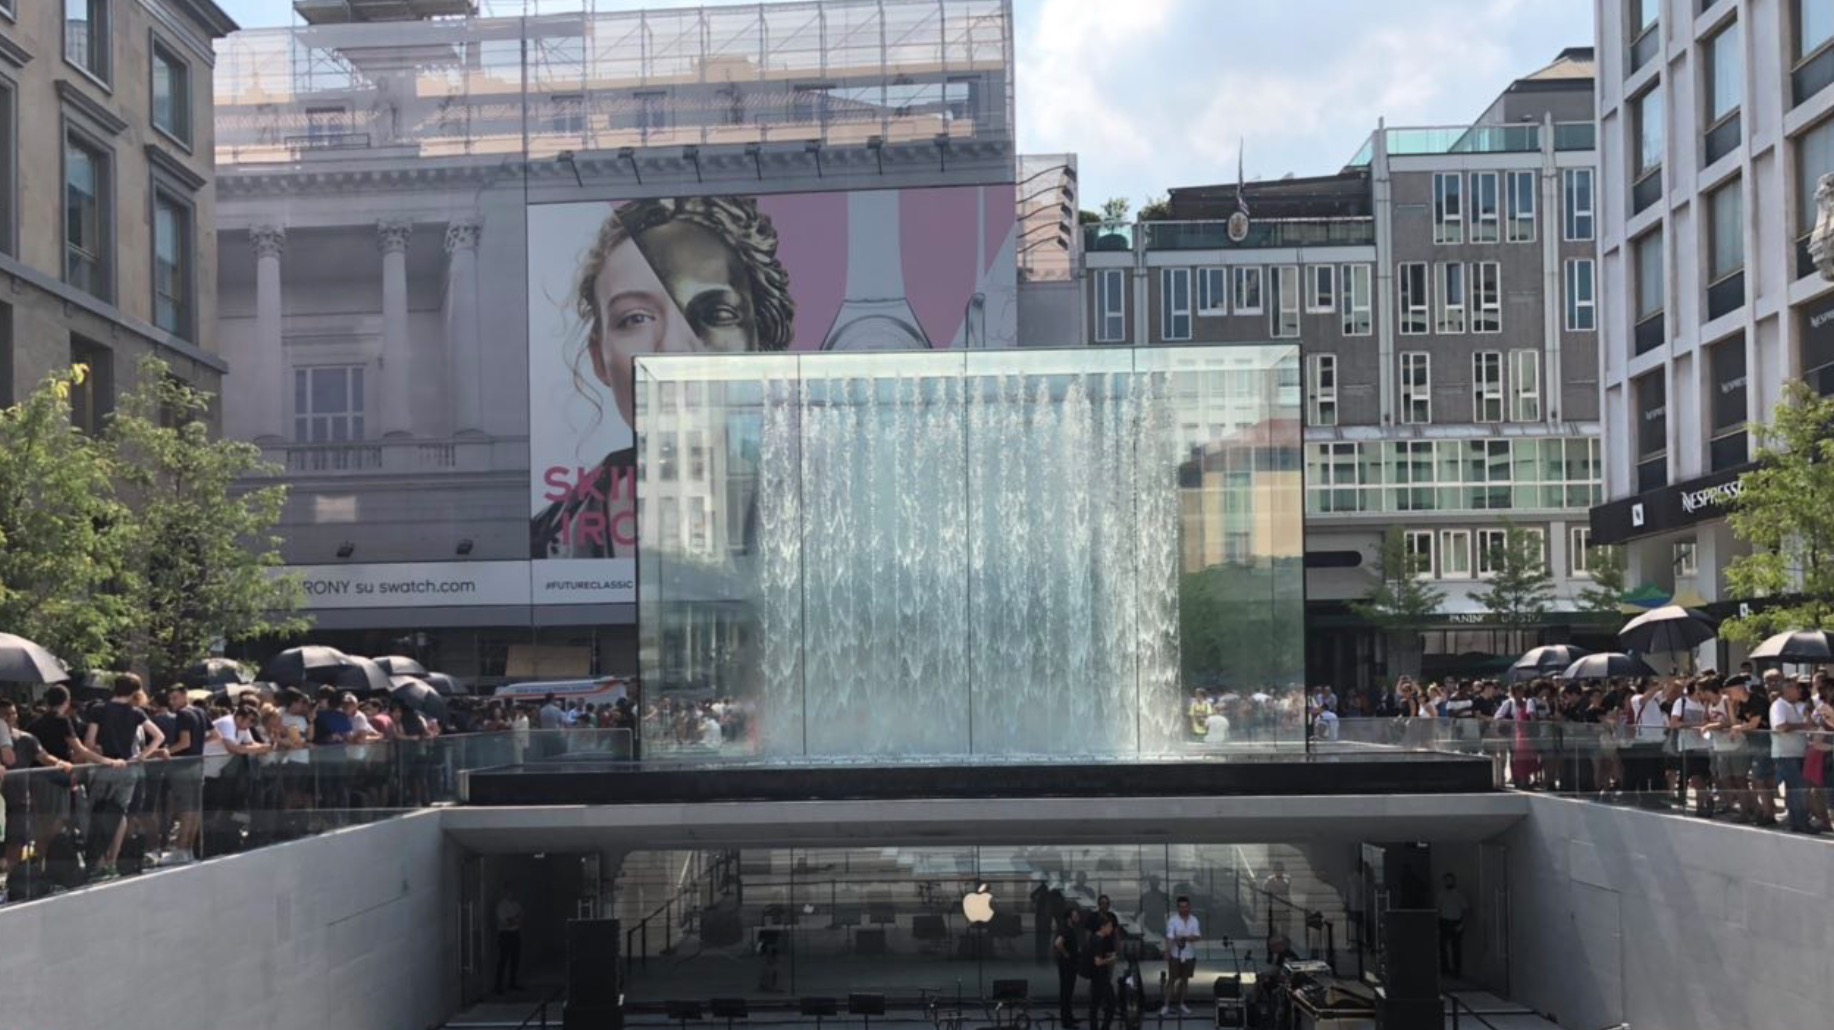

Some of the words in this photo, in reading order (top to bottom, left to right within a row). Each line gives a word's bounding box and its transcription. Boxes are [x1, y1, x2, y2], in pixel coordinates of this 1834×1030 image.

[356, 581, 374, 594] su
[379, 579, 475, 594] swatch.com
[546, 580, 634, 590] #FUTURECLASSIC
